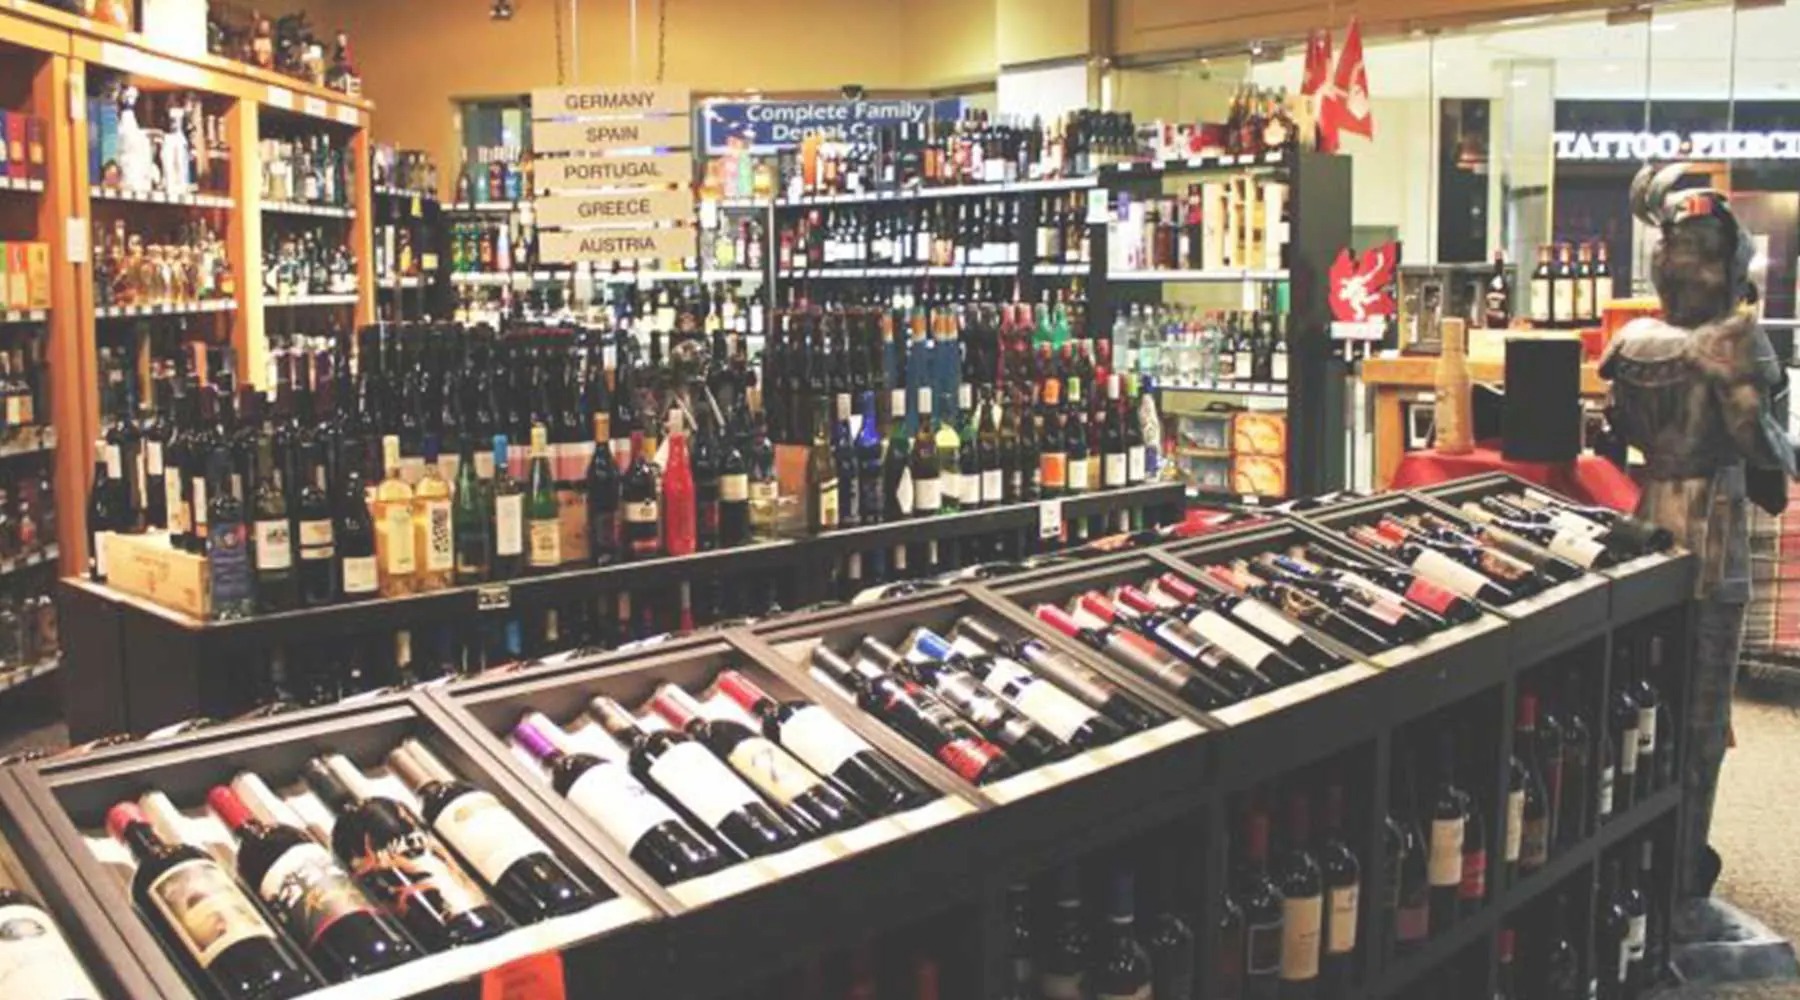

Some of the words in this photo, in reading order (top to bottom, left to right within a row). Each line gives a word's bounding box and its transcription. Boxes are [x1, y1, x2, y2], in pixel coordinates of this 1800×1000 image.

[564, 91, 655, 110] GERMANY
[746, 102, 849, 124] Complete
[854, 101, 925, 122] Family
[586, 126, 639, 142] SPAIN
[1552, 130, 1679, 159] TATTOO
[564, 162, 662, 179] PORTUGAL
[578, 198, 651, 218] GREECE
[579, 236, 656, 253] AUSTRIA
